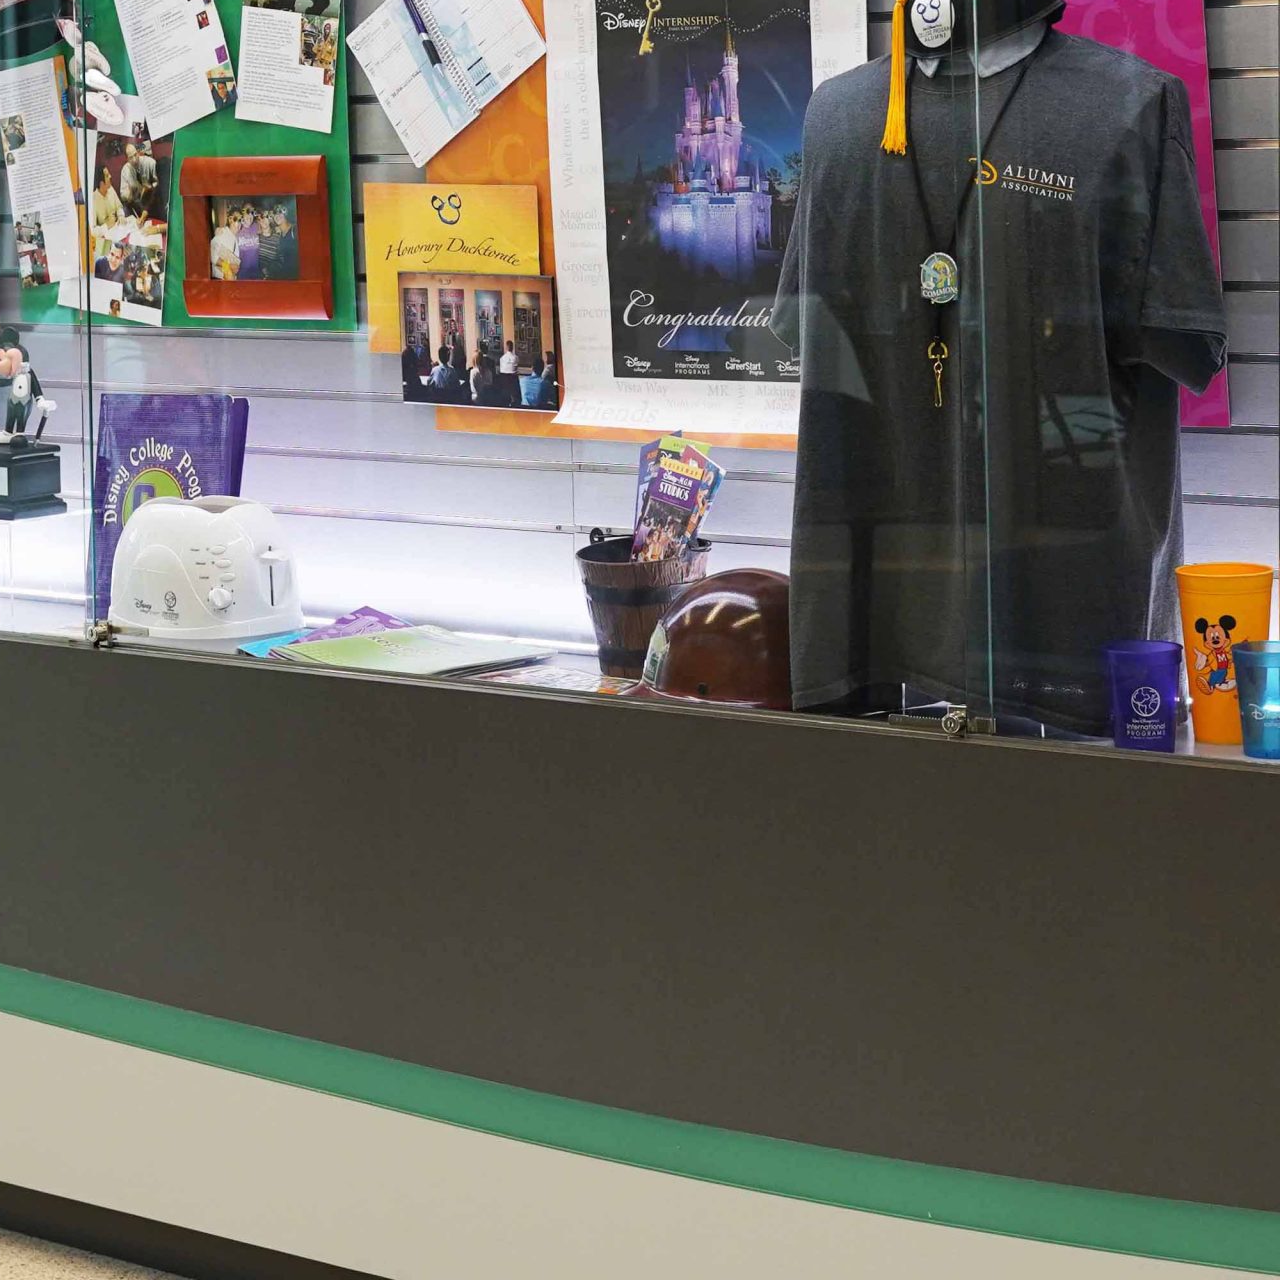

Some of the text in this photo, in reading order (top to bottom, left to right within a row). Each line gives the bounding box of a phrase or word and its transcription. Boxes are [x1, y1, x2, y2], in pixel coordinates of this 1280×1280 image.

[653, 15, 720, 27] INTERNSHIPS
[924, 33, 946, 42] ALUMNI
[562, 154, 573, 188] What
[1002, 164, 1075, 189] ALUMNI
[1001, 181, 1073, 201] ASSOCIATION
[386, 237, 520, 266] Honorary Ducktorate
[561, 261, 603, 274] Grocery
[675, 361, 710, 370] International
[725, 361, 762, 371] CareerStart
[774, 359, 800, 372] Disne
[616, 381, 668, 396] Vista Way
[756, 385, 796, 399] Making
[569, 399, 658, 423] Friends
[103, 437, 203, 527] Disney College Prog
[658, 481, 690, 501] STUDIOS
[1217, 653, 1228, 663] M
[1126, 722, 1166, 730] International
